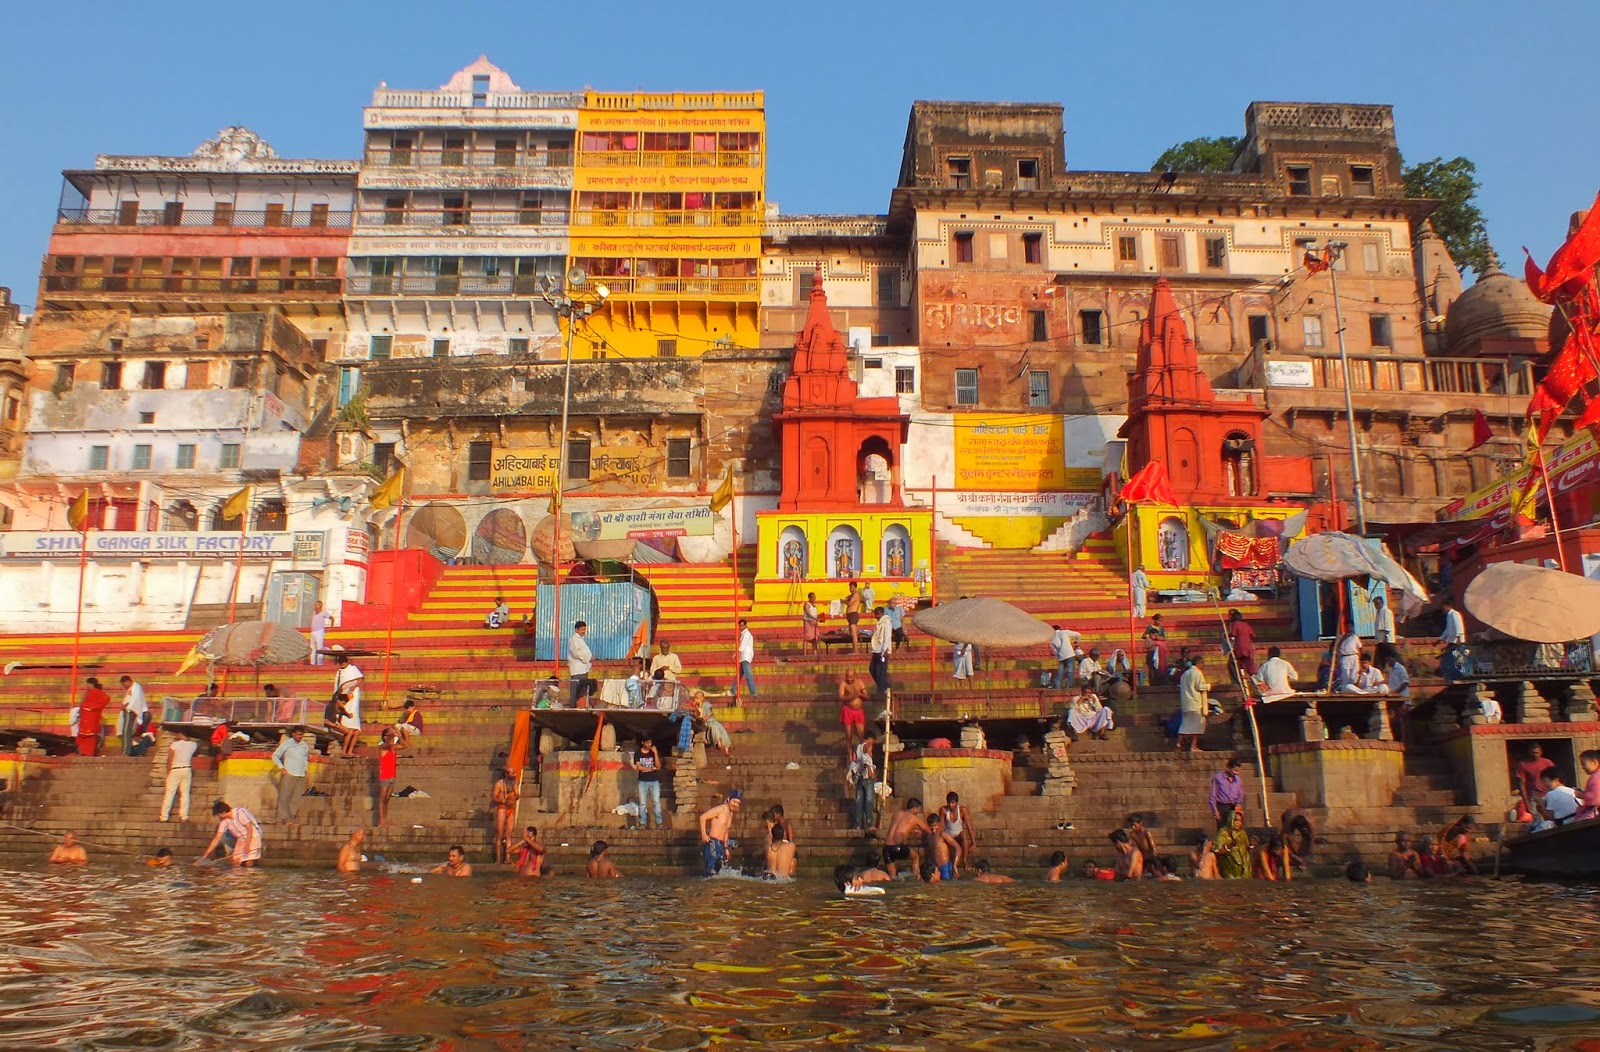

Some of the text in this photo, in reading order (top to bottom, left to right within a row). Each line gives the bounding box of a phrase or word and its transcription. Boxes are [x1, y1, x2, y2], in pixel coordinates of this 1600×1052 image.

[493, 454, 547, 471] अहिल्याबाई
[1566, 460, 1595, 480] RUPA
[492, 476, 535, 488] AHILYABAI
[603, 507, 710, 524] श्री श्री काशी गंगा सेवा समिति
[36, 536, 275, 550] SHIV GANGA SILK FACTORY
[306, 534, 322, 542] KINDS
